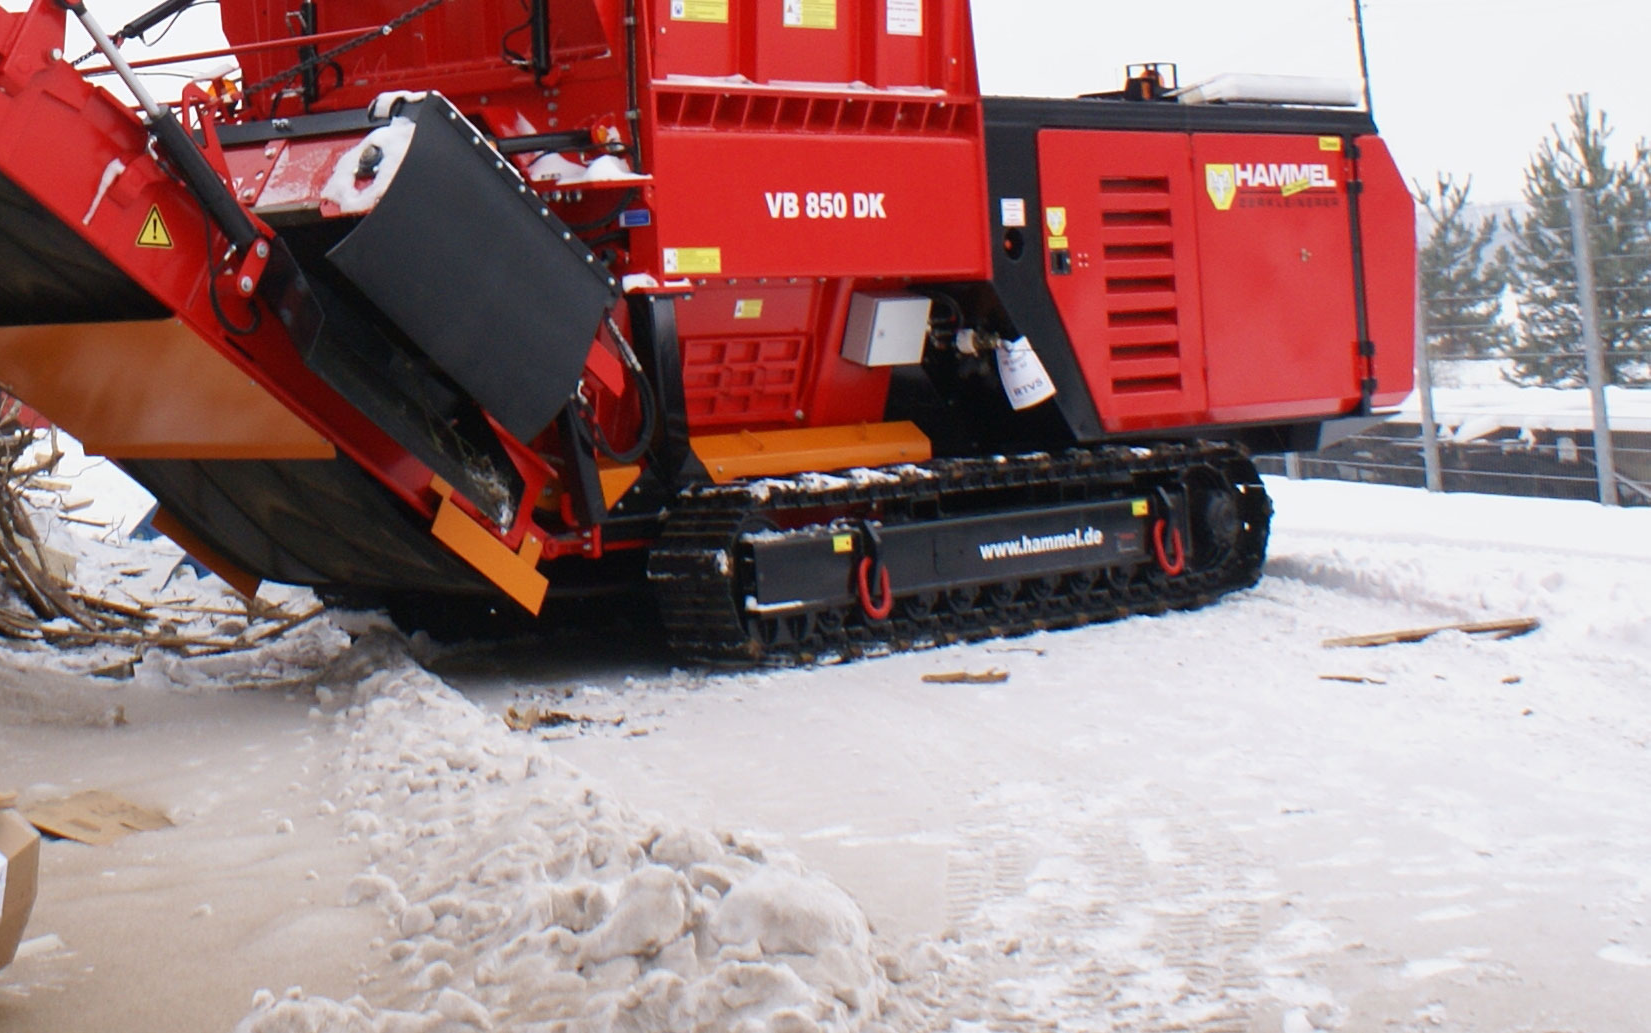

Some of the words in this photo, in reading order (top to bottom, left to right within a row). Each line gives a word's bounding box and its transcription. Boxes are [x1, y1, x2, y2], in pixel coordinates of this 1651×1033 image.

[1234, 163, 1337, 187] HAMMEL
[764, 192, 800, 219] VB
[805, 192, 848, 219] 850
[853, 192, 887, 219] DK
[979, 526, 1104, 560] www.hammel.de
